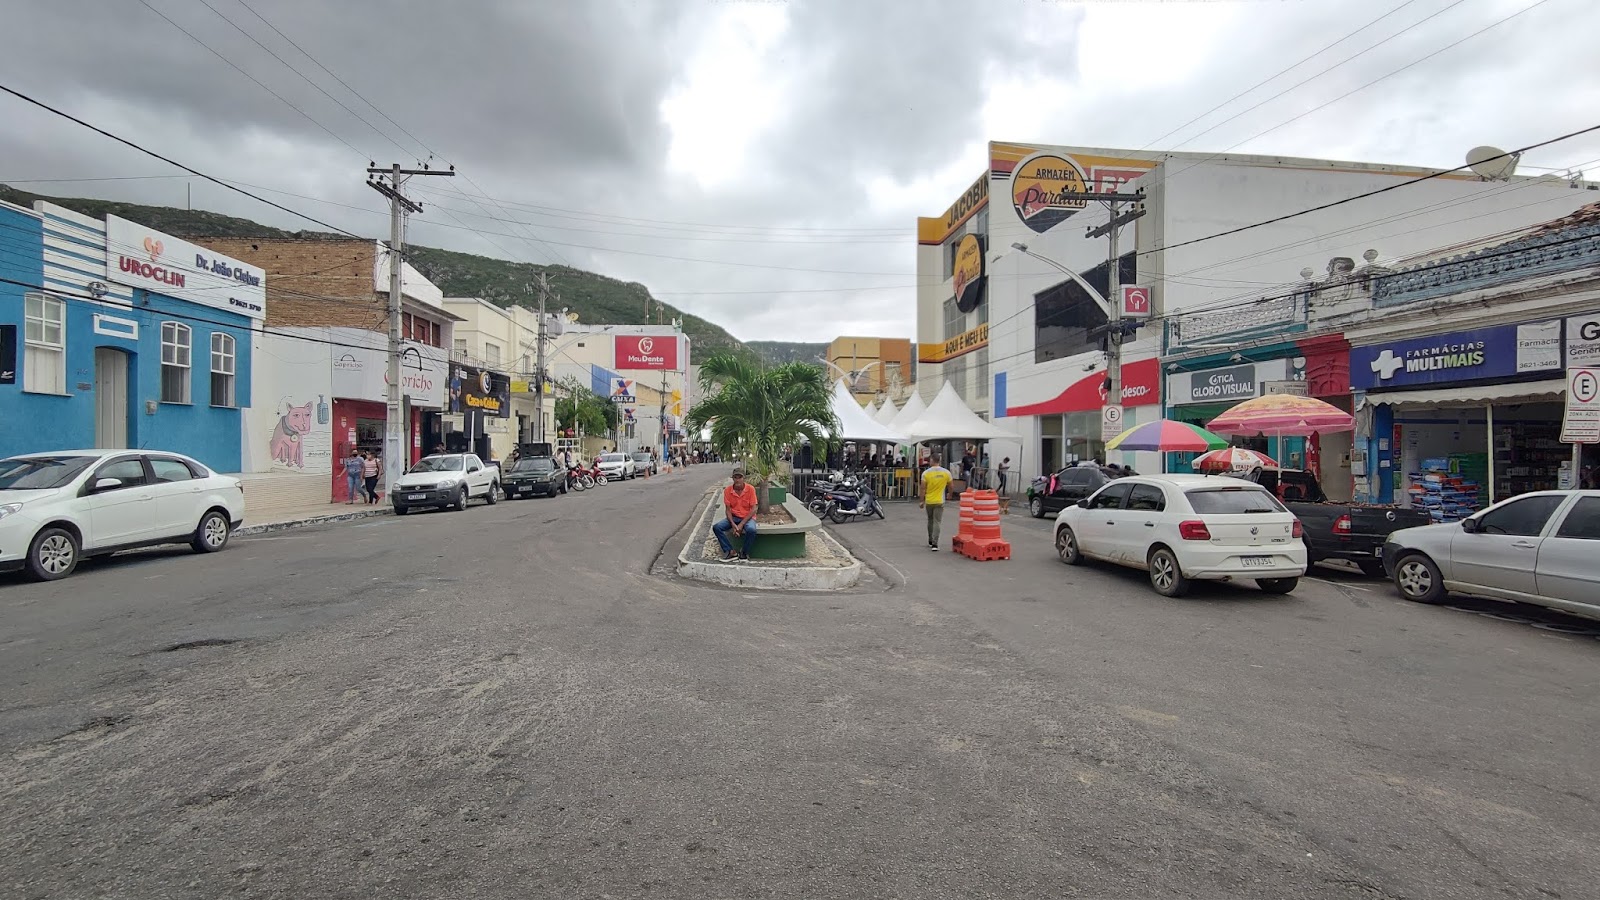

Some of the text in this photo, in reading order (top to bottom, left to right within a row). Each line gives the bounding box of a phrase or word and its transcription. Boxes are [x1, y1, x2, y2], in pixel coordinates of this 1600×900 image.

[1036, 167, 1075, 180] ARMAZÉM
[119, 256, 186, 288] UROCLIN
[196, 253, 260, 286] Dr. João Cleber
[1580, 321, 1600, 341] G
[1406, 341, 1484, 358] FARMÁCIAS
[1406, 351, 1484, 373] MULTMAIS
[1192, 385, 1221, 398] GLOBO
[1222, 381, 1254, 395] VISUAL
[1581, 379, 1590, 395] E
[1110, 410, 1116, 419] E
